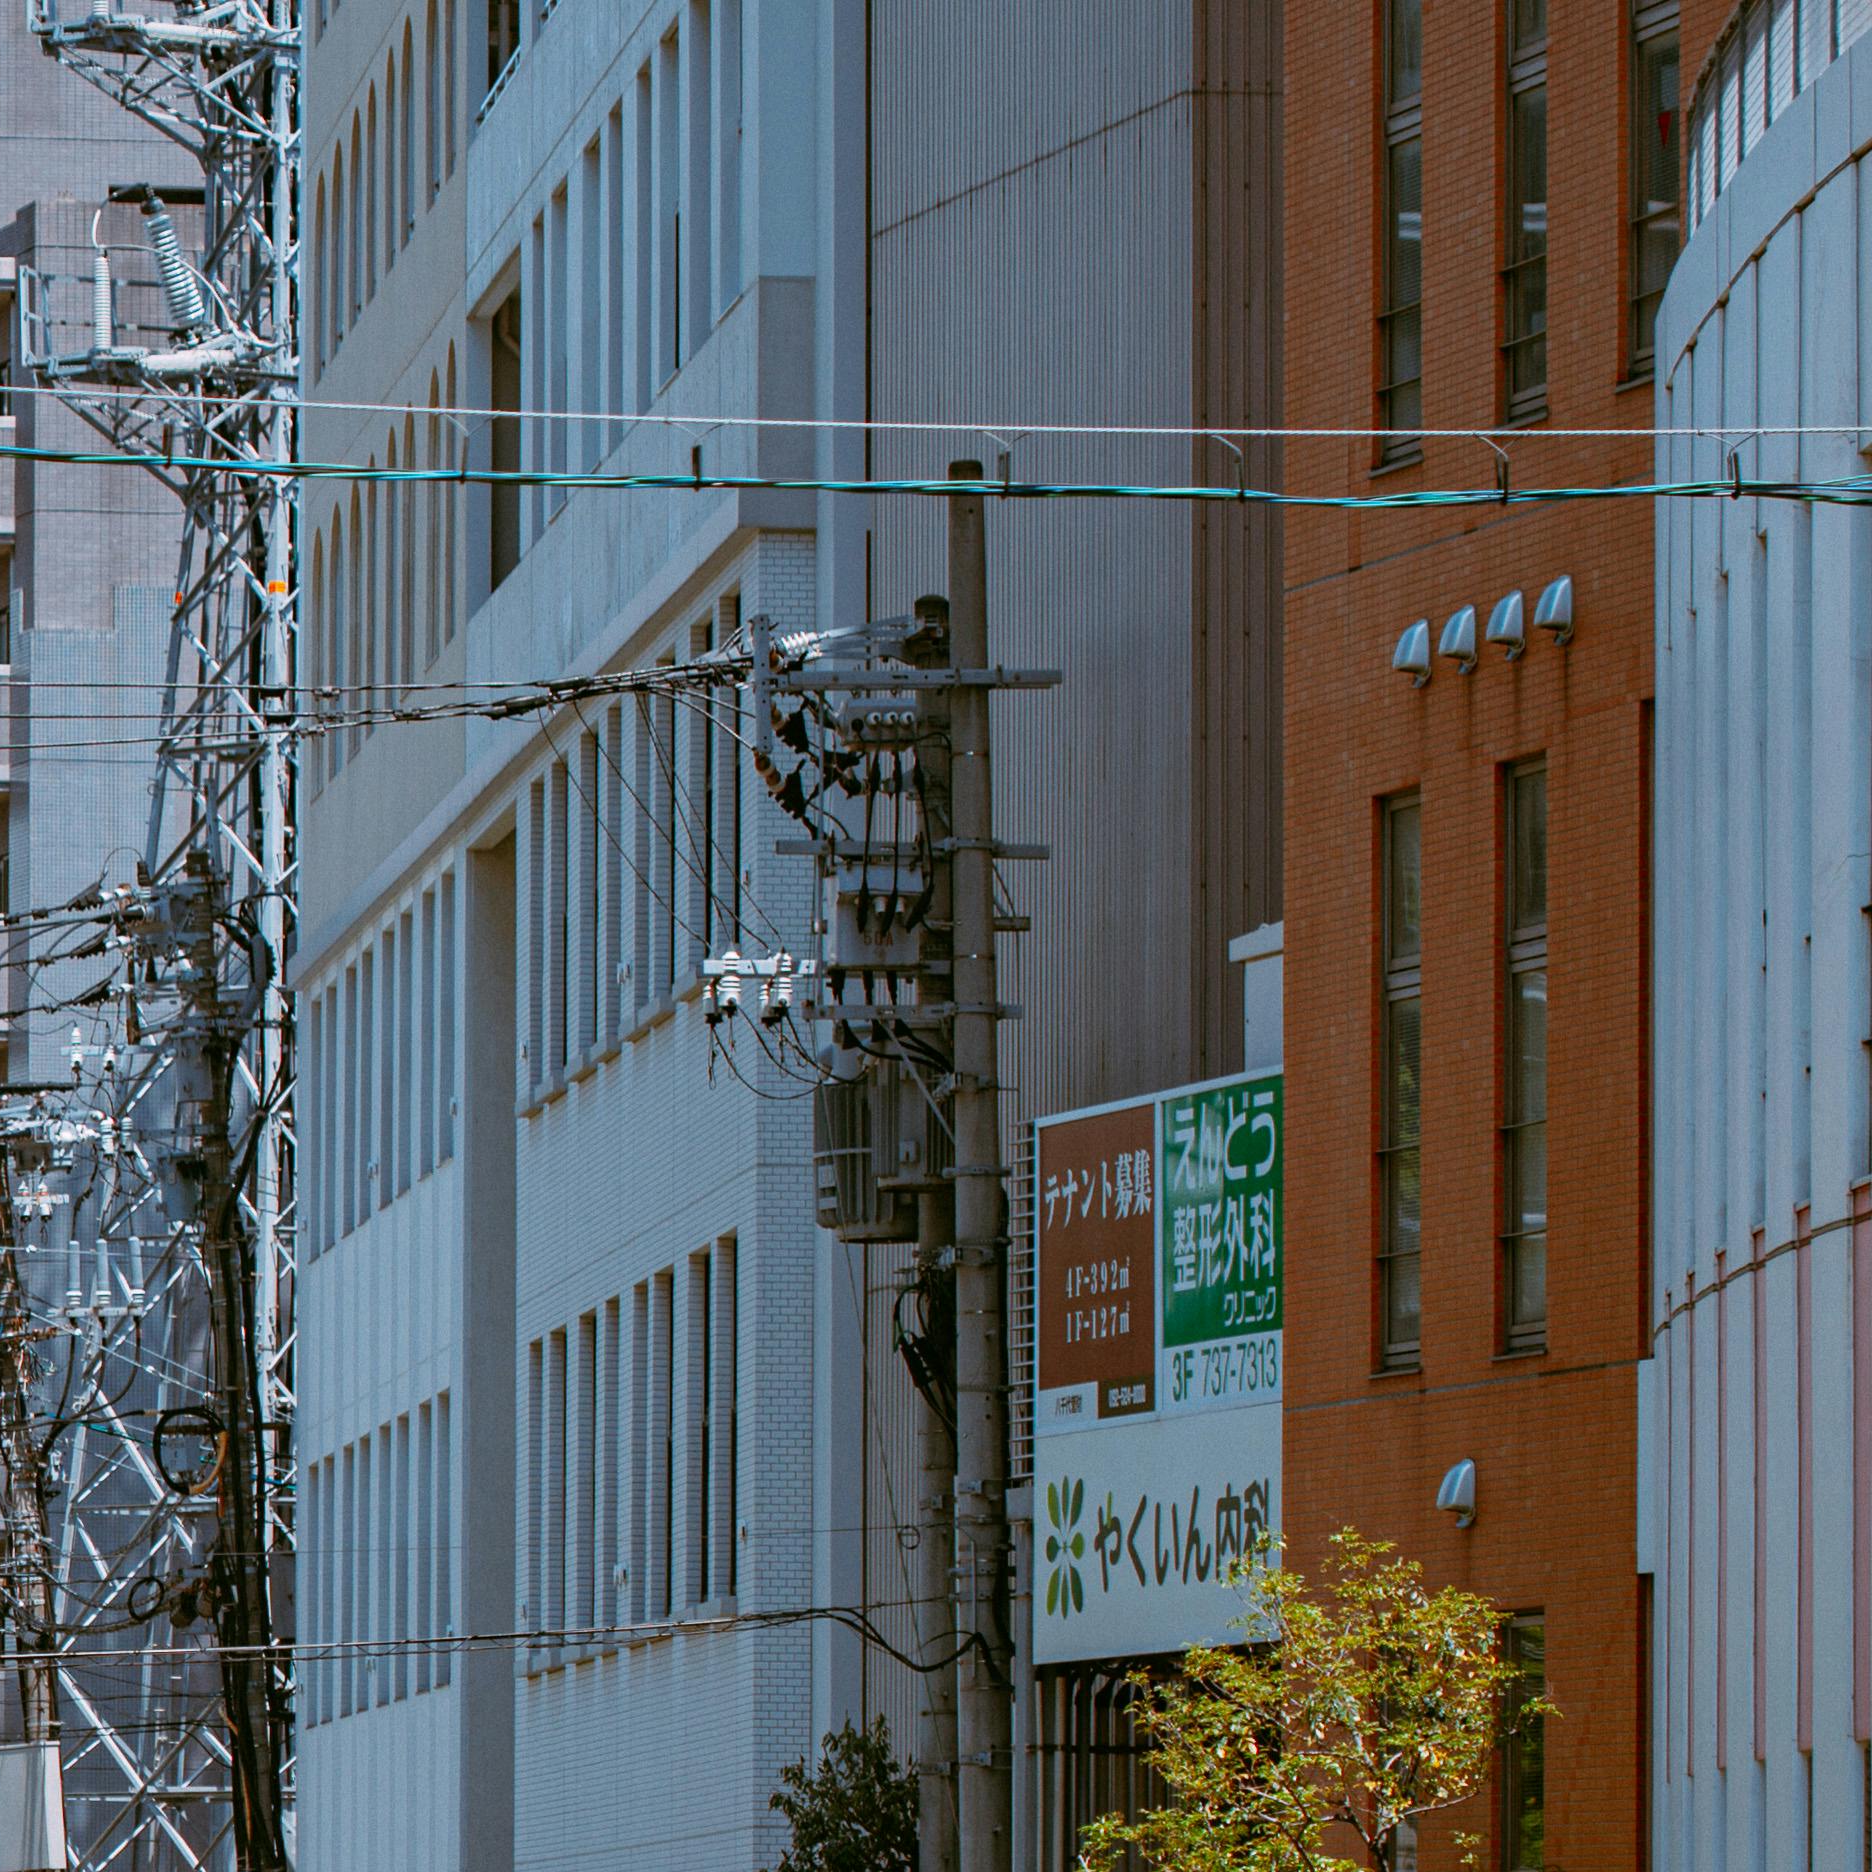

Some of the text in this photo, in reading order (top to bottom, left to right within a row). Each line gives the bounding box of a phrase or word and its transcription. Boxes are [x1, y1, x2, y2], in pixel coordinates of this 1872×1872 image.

[1173, 1090, 1276, 1192] えんどう
[1044, 1149, 1153, 1232] テナント募集
[1173, 1188, 1276, 1293] 整形外科
[1224, 1286, 1277, 1328] クリニック
[1172, 1337, 1277, 1402] 3F 737-7313
[1094, 1477, 1269, 1594] やくいん内科
